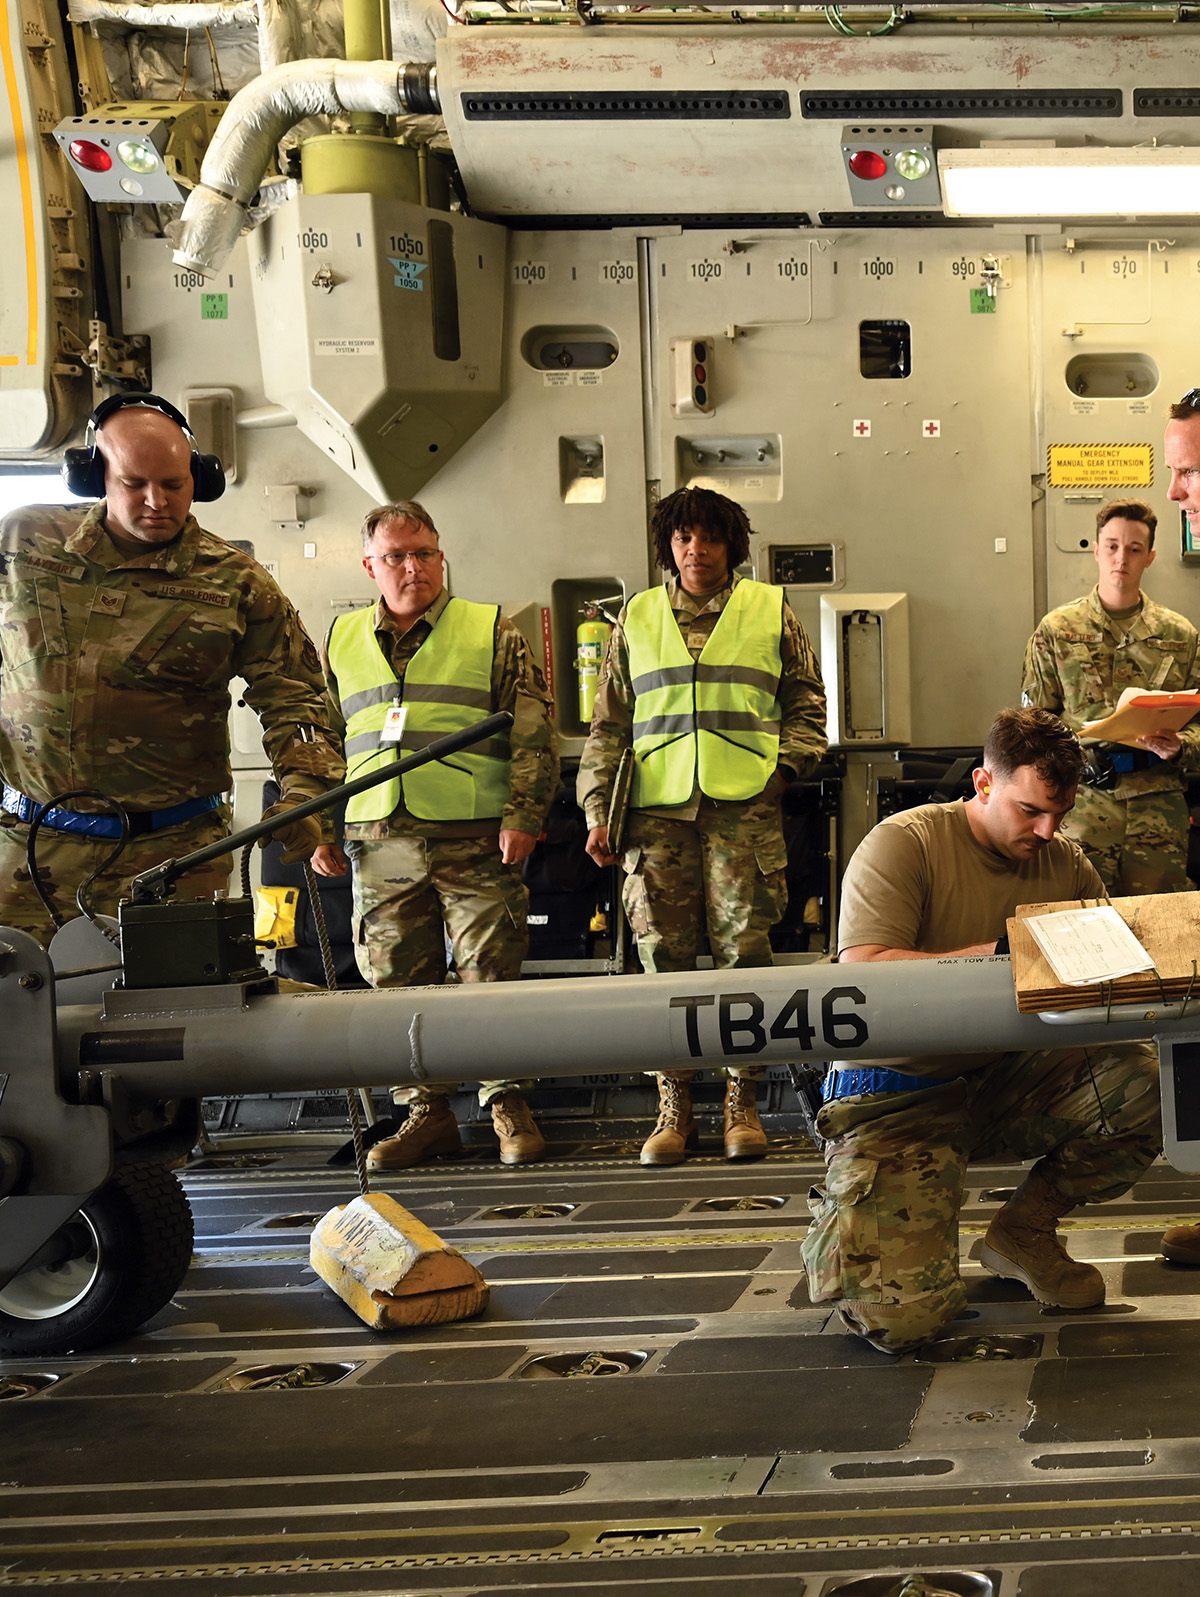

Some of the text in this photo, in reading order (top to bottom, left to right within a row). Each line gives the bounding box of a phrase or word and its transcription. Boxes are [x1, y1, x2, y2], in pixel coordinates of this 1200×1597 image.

[296, 233, 328, 248] 1060
[389, 235, 424, 256] 1050
[399, 261, 417, 272] PP 7
[514, 265, 546, 280] 1040
[603, 265, 634, 280] 1030
[691, 263, 722, 278] 1020
[777, 262, 808, 276] 1010
[863, 261, 894, 276] 1000
[952, 261, 975, 276] 990
[1113, 260, 1137, 274] 970
[174, 273, 205, 288] 1080
[399, 278, 418, 289] 1050
[974, 289, 984, 297] PP
[206, 311, 223, 319] 1077
[1080, 450, 1121, 458] EMERGENCY
[1107, 459, 1144, 467] EXTENSION
[179, 588, 195, 599] AIR
[197, 591, 227, 606] FORCE
[292, 991, 337, 999] RETRACT
[669, 986, 869, 1058] TB46
